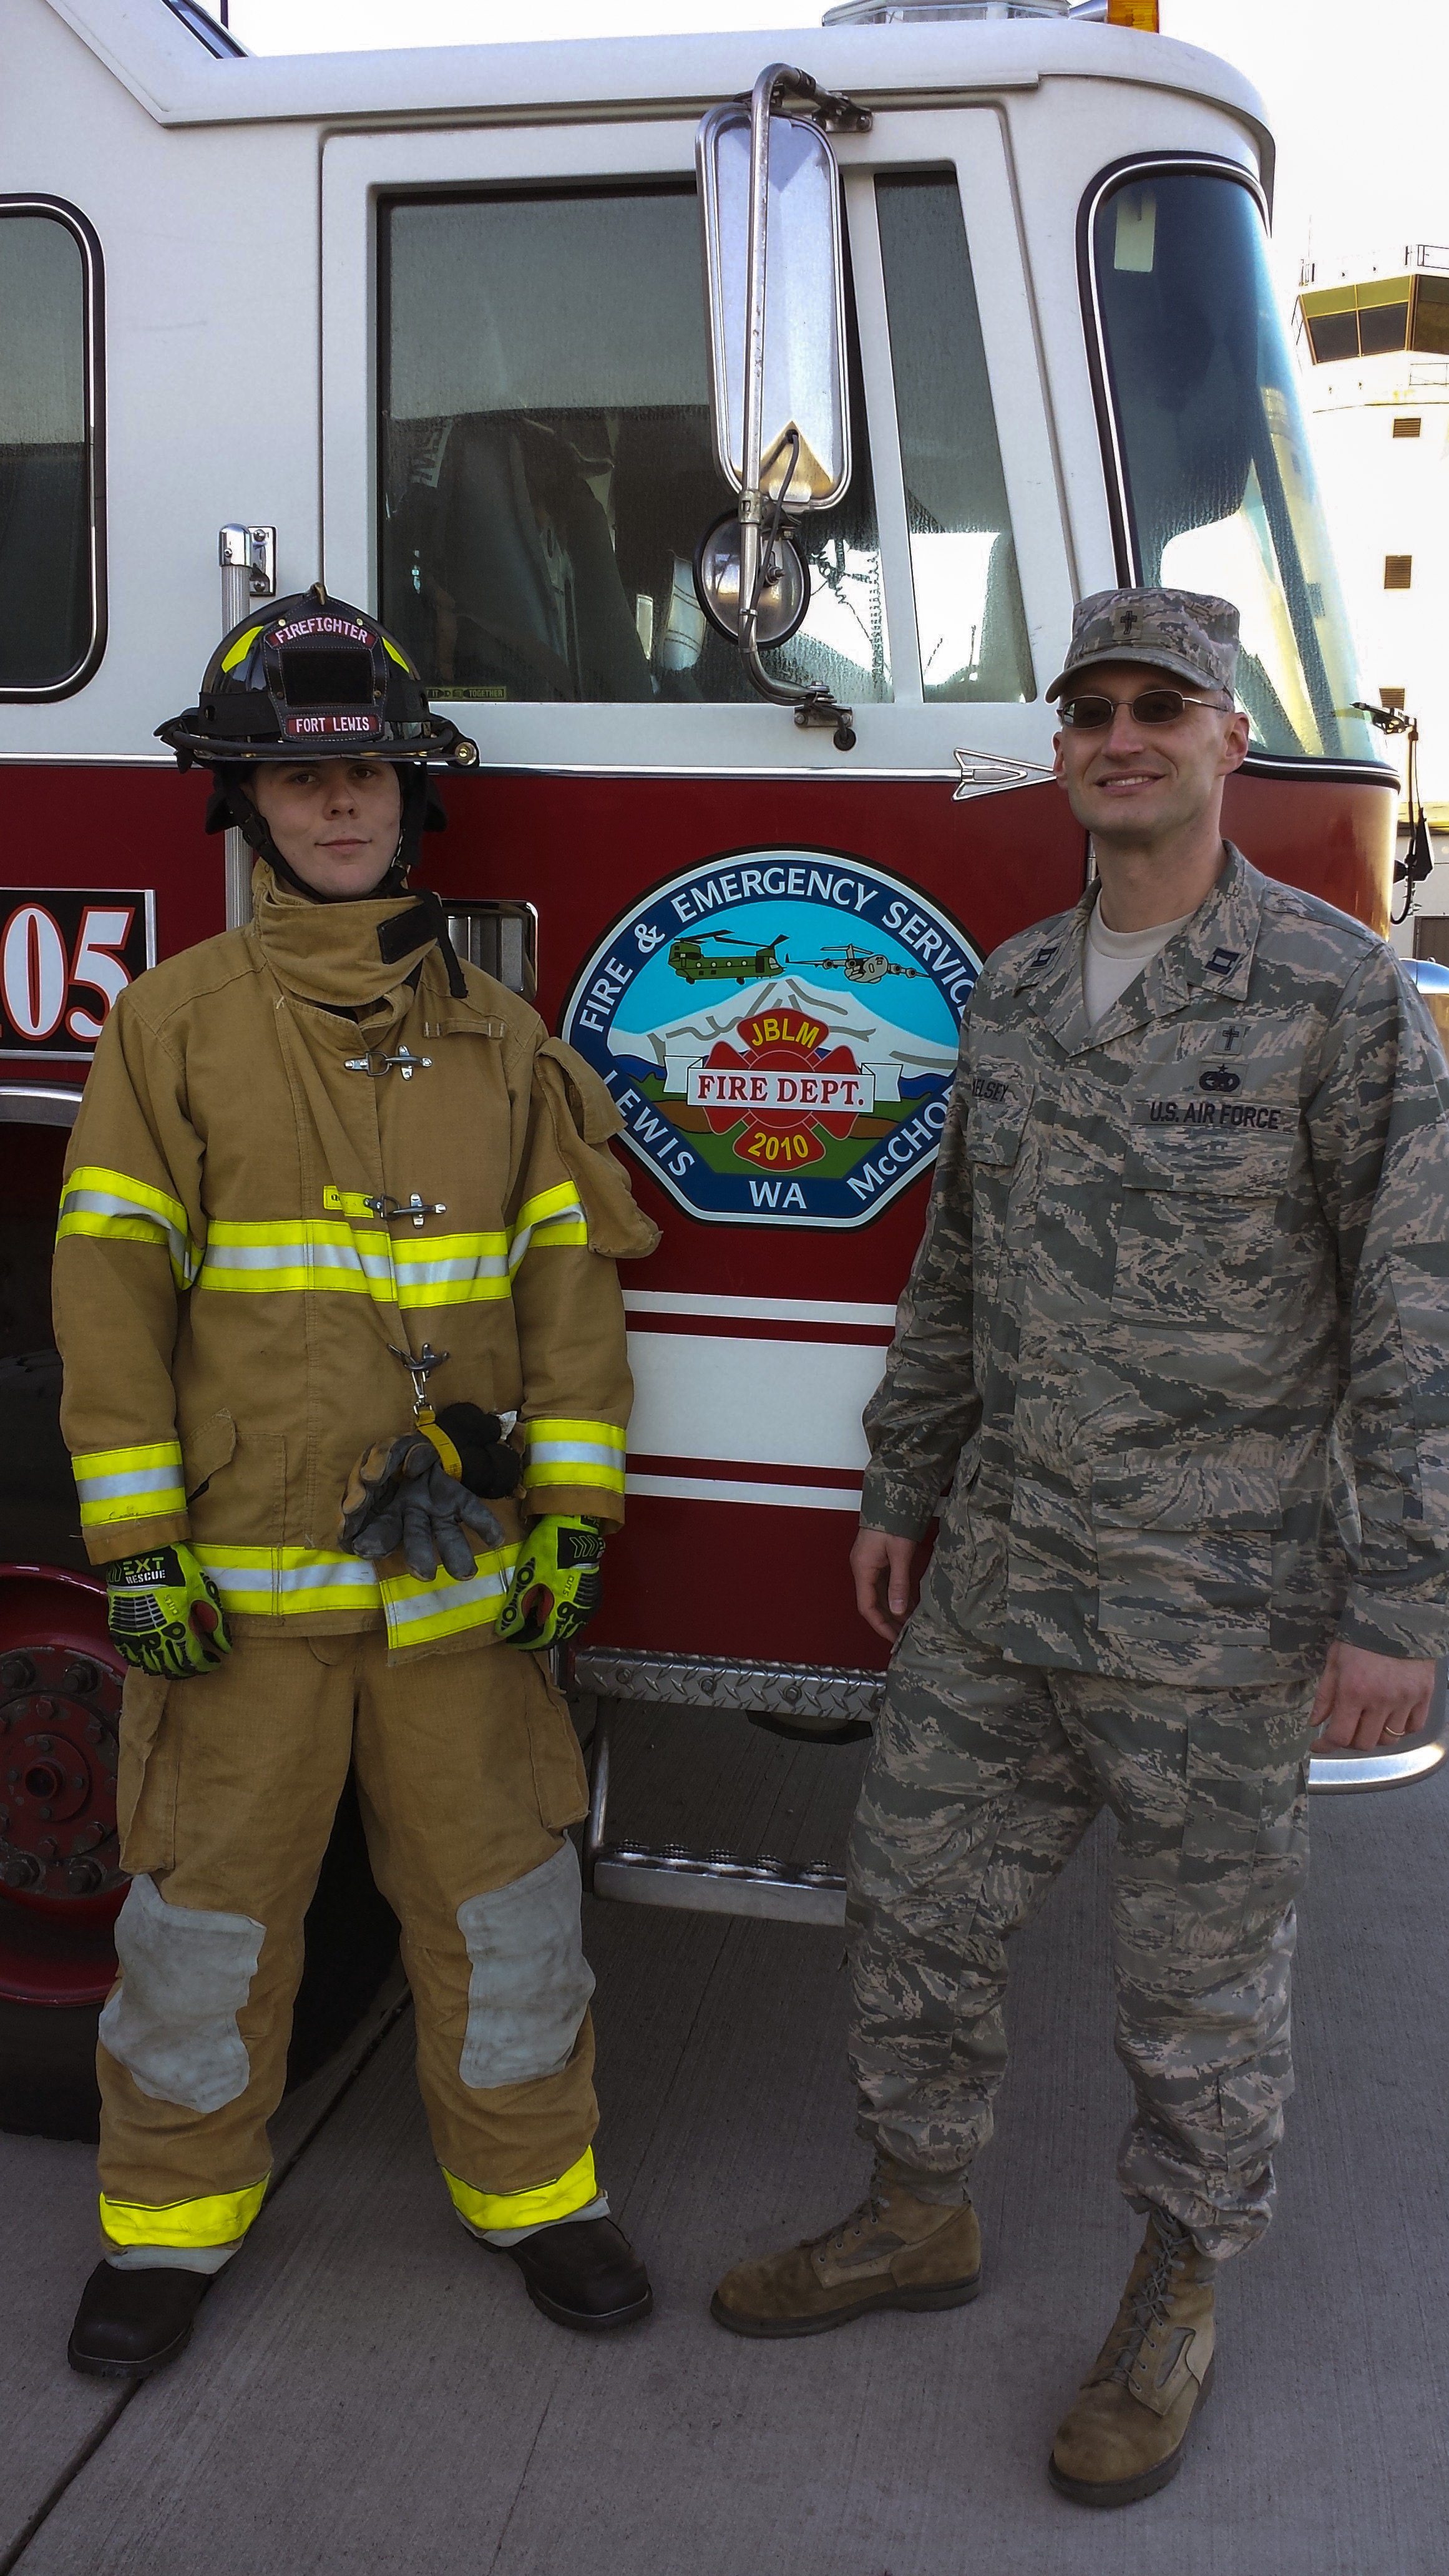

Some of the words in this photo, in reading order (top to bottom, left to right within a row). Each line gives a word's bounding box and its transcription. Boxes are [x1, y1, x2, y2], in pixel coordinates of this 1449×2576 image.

[275, 617, 368, 644] FIREFIGHTER
[469, 689, 504, 698] TOGETHER
[296, 718, 326, 733] FORT
[333, 716, 370, 731] LEWIS
[579, 957, 634, 1033] FIRE
[634, 923, 666, 954] &
[670, 867, 879, 924] EMERGENCY
[881, 901, 975, 1019] SERVIC
[0, 902, 136, 1043] 05
[751, 1018, 820, 1049] JBLM
[697, 1074, 769, 1102] FIRE
[776, 1077, 865, 1106] DEPT.
[1149, 1101, 1179, 1123] U.S.
[1183, 1102, 1216, 1124] AIR
[1219, 1104, 1282, 1129] FORCE
[747, 1132, 809, 1161] 2010
[846, 1084, 954, 1201] McCHO
[749, 1180, 807, 1209] WA
[123, 1556, 164, 1576] EXT
[125, 1569, 166, 1584] RESCUE
